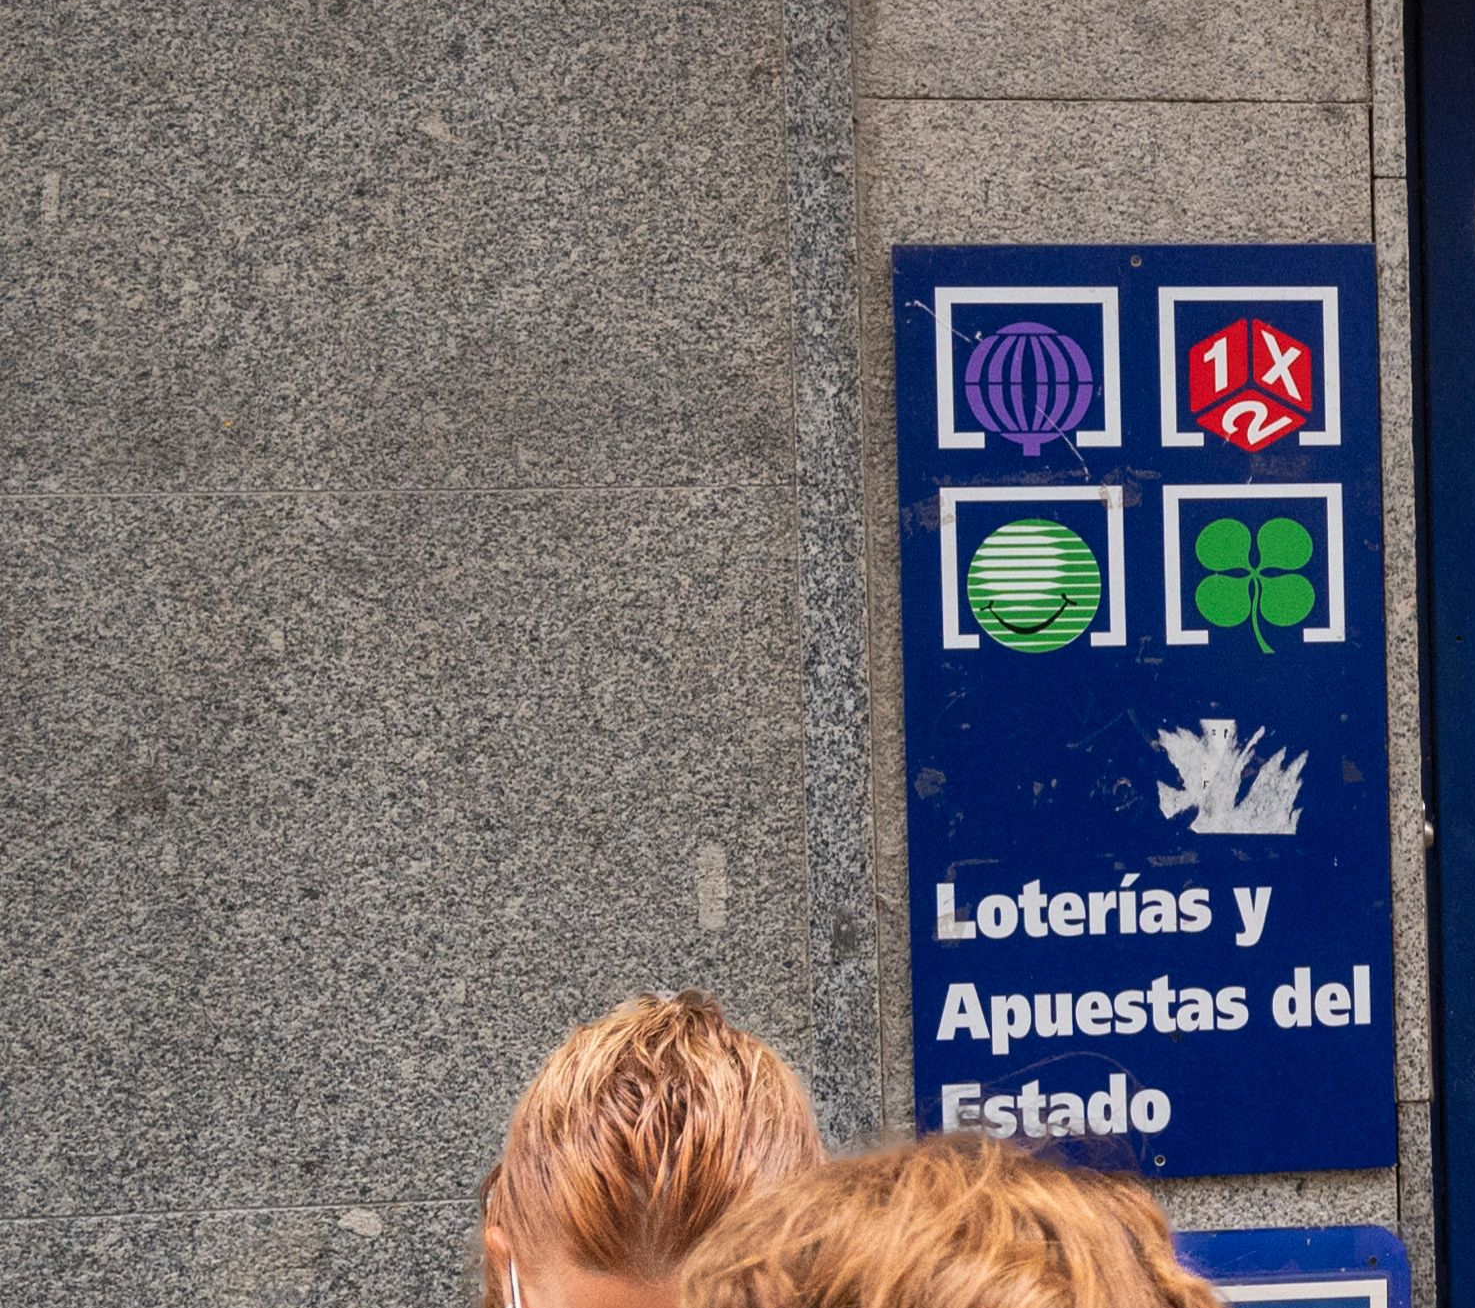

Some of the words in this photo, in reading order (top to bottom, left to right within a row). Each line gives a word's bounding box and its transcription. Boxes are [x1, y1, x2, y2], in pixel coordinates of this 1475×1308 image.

[936, 872, 1213, 941] Loterías
[1233, 886, 1273, 947] y
[936, 974, 1249, 1056] Apuestas
[1271, 964, 1371, 1029] del
[940, 1072, 1172, 1139] Estado
